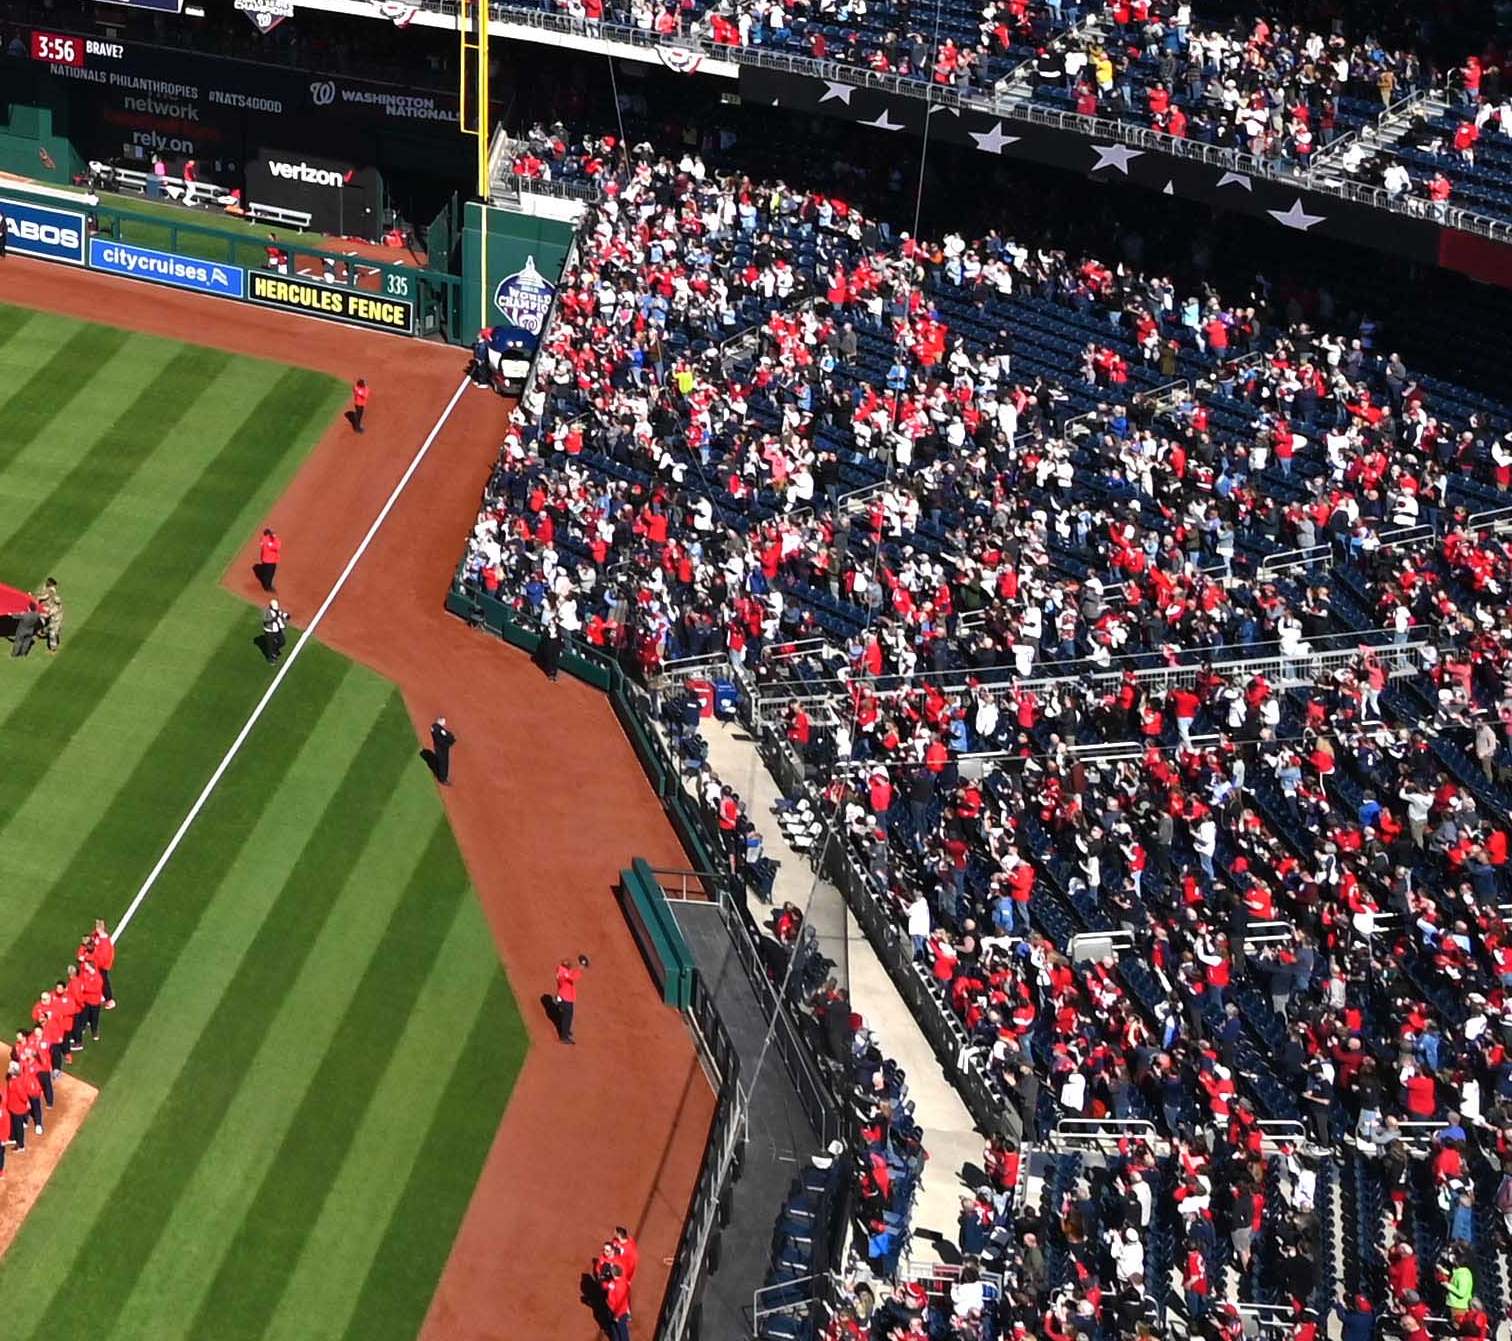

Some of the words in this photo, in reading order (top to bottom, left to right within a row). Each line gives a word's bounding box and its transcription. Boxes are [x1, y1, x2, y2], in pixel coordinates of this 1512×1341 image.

[37, 35, 75, 62] 3:56
[85, 40, 125, 59] BRAVE?
[49, 63, 107, 84] NATIONALS
[109, 73, 199, 100] PHILANTHROPIES
[208, 90, 283, 114] #NATS4GOOD
[341, 89, 435, 110] WASHINGTON
[123, 95, 201, 122] network
[132, 129, 168, 151] rely
[169, 139, 195, 155] on
[267, 159, 344, 188] verizon
[101, 245, 208, 283] citycruises
[386, 273, 408, 296] 335
[508, 286, 552, 306] WORLD
[255, 277, 343, 314] HERCULES
[348, 296, 405, 326] FENCE
[498, 295, 549, 314] CHAMPIO
